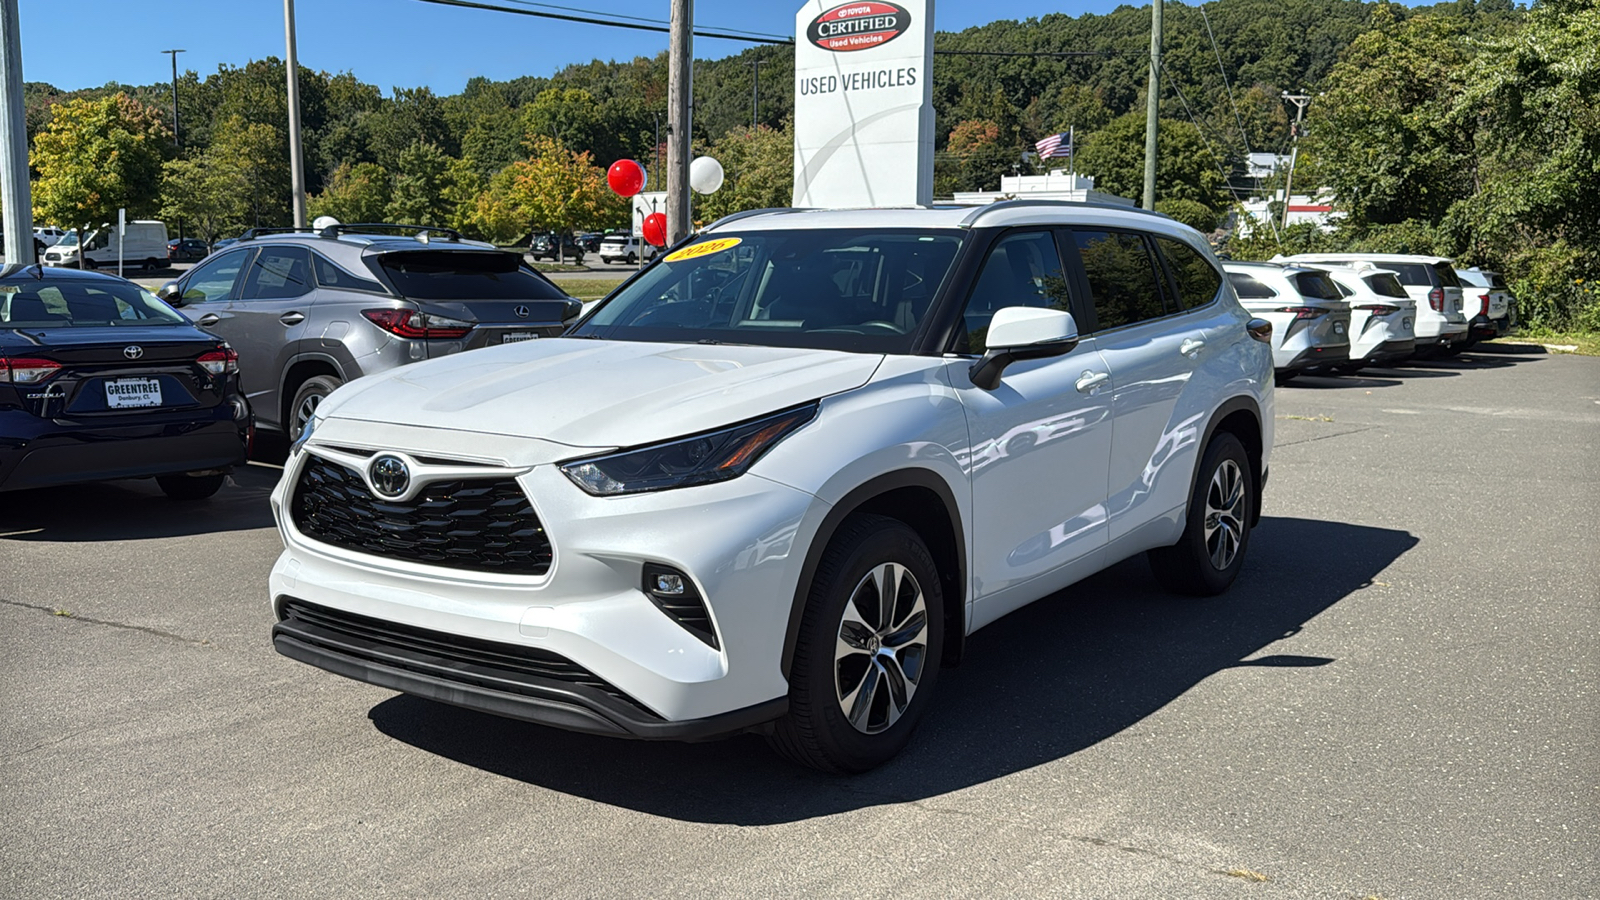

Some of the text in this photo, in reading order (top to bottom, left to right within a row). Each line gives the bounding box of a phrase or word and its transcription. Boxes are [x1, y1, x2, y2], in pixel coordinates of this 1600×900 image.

[847, 6, 871, 15] TOYOTA
[817, 15, 897, 37] CERTIFIED
[829, 35, 883, 48] Used Vehicles
[800, 67, 917, 96] USED VEHICLES
[673, 240, 728, 260] 2026
[107, 383, 159, 395] GREENTREE
